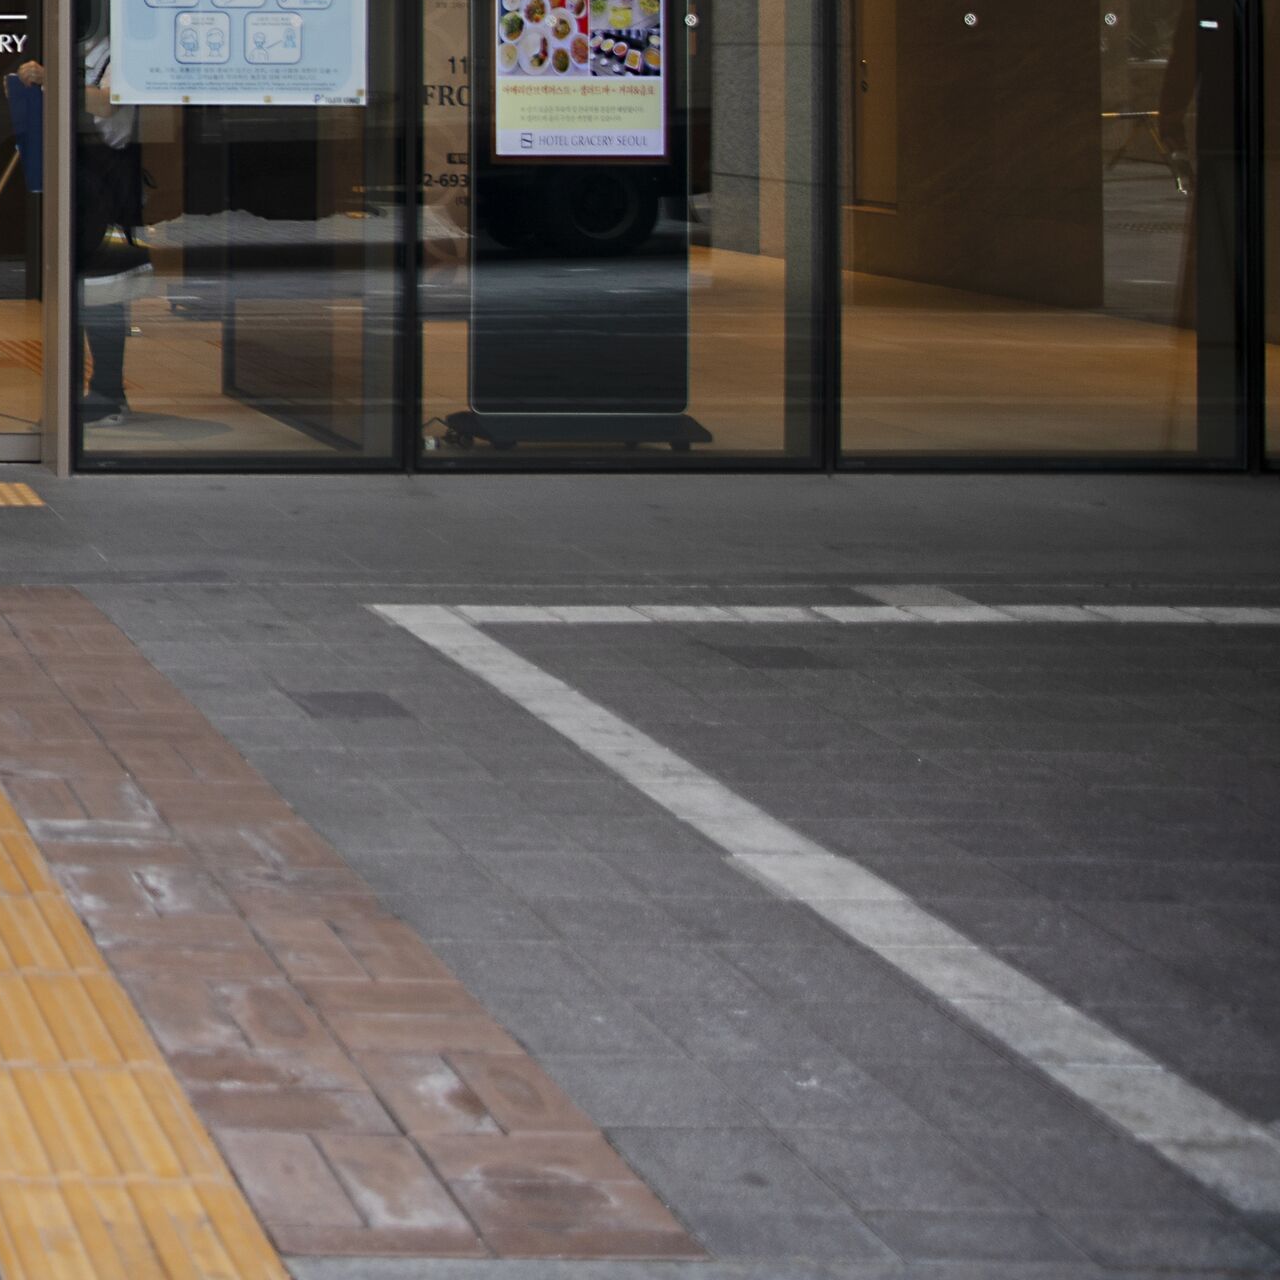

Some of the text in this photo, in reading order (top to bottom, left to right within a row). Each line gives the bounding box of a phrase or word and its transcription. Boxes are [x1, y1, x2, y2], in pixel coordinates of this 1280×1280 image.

[538, 135, 648, 147] HOTEL GRACERY SEOUL
